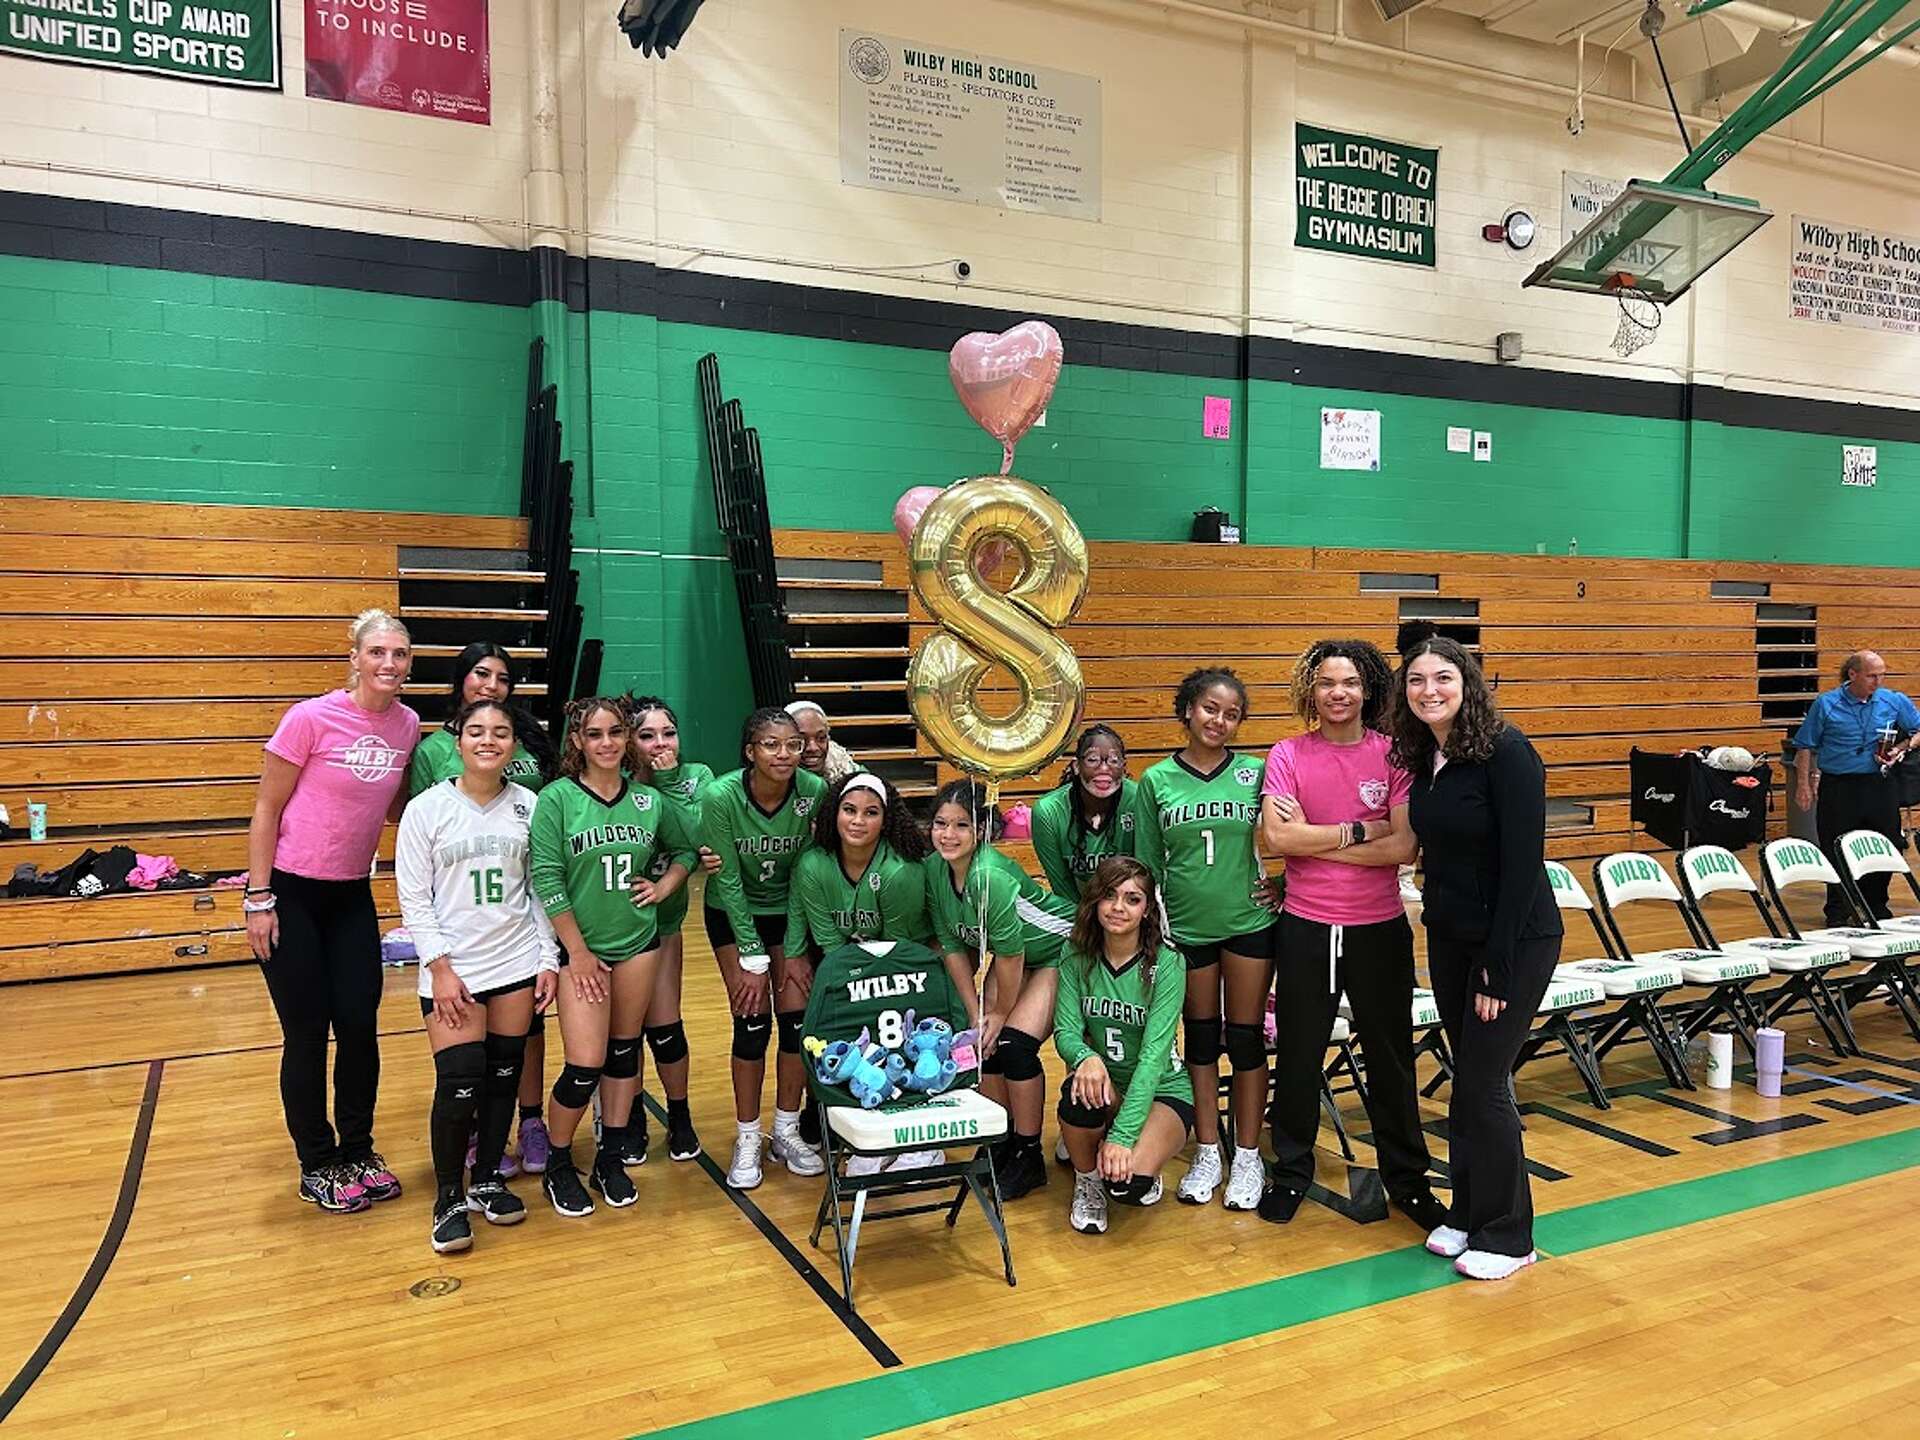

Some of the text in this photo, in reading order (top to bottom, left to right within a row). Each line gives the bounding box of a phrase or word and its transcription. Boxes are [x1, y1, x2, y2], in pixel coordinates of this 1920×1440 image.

[129, 0, 172, 26] CUP
[181, 6, 250, 38] AWARD
[316, 10, 475, 53] TO INCLUDE.
[9, 12, 245, 71] UNIFIED SPORTS
[904, 49, 945, 71] WILBY
[952, 59, 983, 79] HIGH
[989, 66, 1038, 90] SCHOOL
[903, 72, 949, 88] PLAYERS
[961, 83, 1024, 104] SPECTATORS
[1028, 96, 1056, 109] CODE
[1301, 143, 1432, 190] WELCOME TO
[1297, 176, 1434, 228] THE REGGIE O'BRIEN
[1309, 216, 1422, 256] GYMNASIUM
[1801, 222, 1843, 254] Wilby
[1847, 231, 1879, 261] High
[1577, 581, 1586, 598] 3
[344, 750, 398, 767] WILBY
[1162, 801, 1259, 830] WILDCATS
[569, 824, 655, 857] WILDCATS
[735, 835, 805, 857] WILDCAT
[1200, 829, 1215, 867] 1
[1849, 836, 1893, 861] WILBY
[600, 852, 633, 892] 12
[759, 860, 776, 882] 3
[1691, 852, 1738, 880] WILBY
[1774, 844, 1823, 870] WILBY
[470, 868, 503, 905] 16
[1608, 859, 1662, 887] WILBY
[1719, 963, 1760, 978] WILDCATS
[1810, 951, 1844, 966] WILDCATS
[847, 972, 927, 1002] WILBY
[1635, 973, 1674, 990] WILDCATS
[1552, 987, 1595, 1008] WILDCATS
[878, 1009, 904, 1049] 8
[1105, 1027, 1126, 1062] 5
[894, 1119, 978, 1144] WILDCATS
